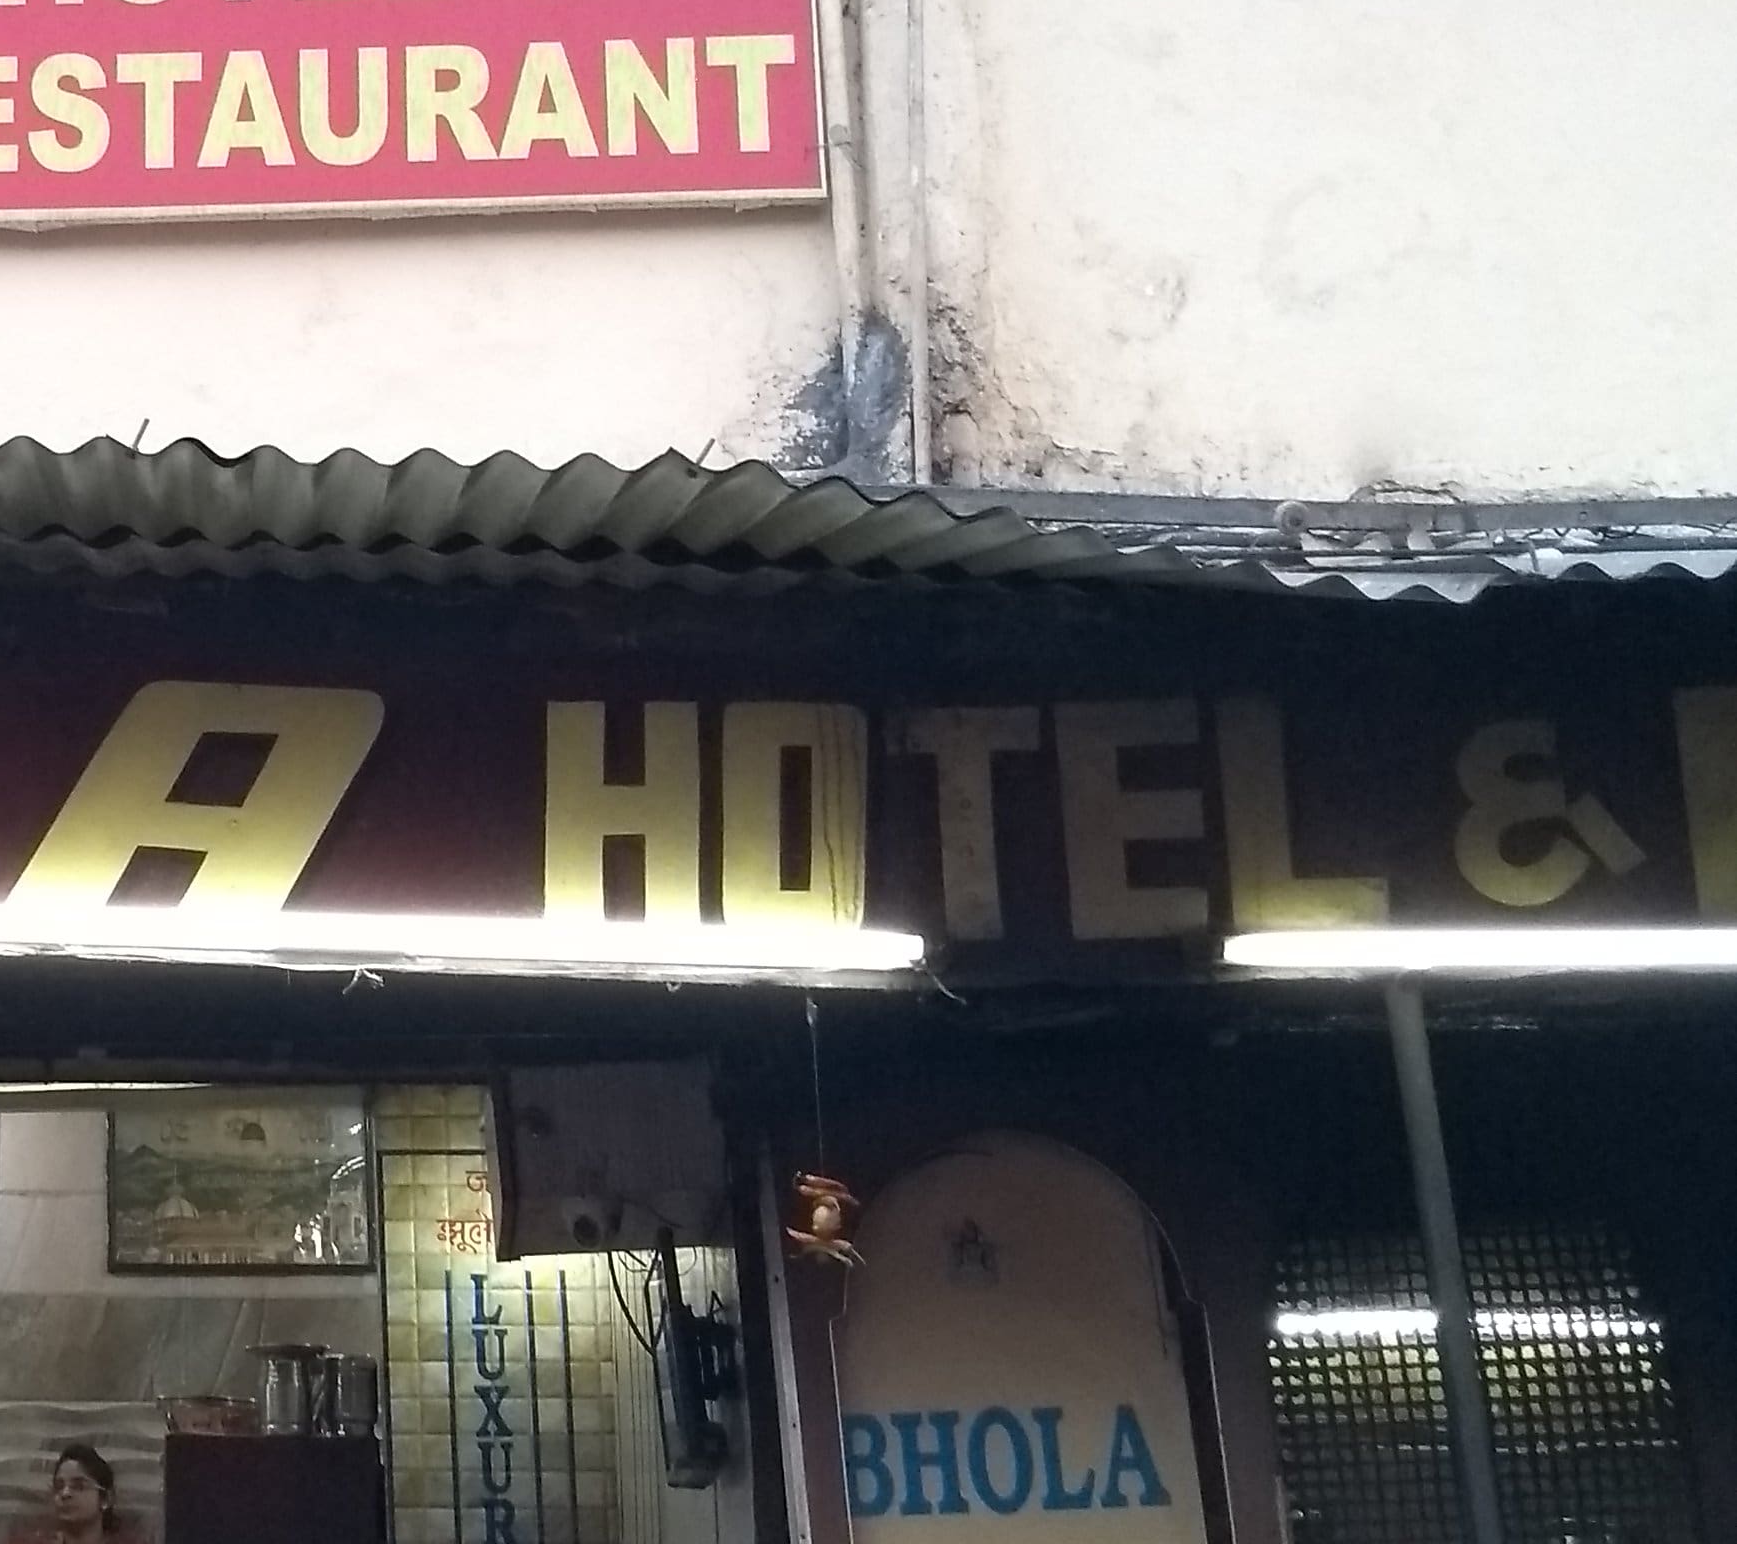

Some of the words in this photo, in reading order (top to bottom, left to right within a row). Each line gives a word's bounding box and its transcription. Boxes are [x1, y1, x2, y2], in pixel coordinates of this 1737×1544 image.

[544, 699, 1391, 941] HOTEL
[1454, 719, 1647, 908] &
[842, 1404, 1171, 1516] BHOLA
